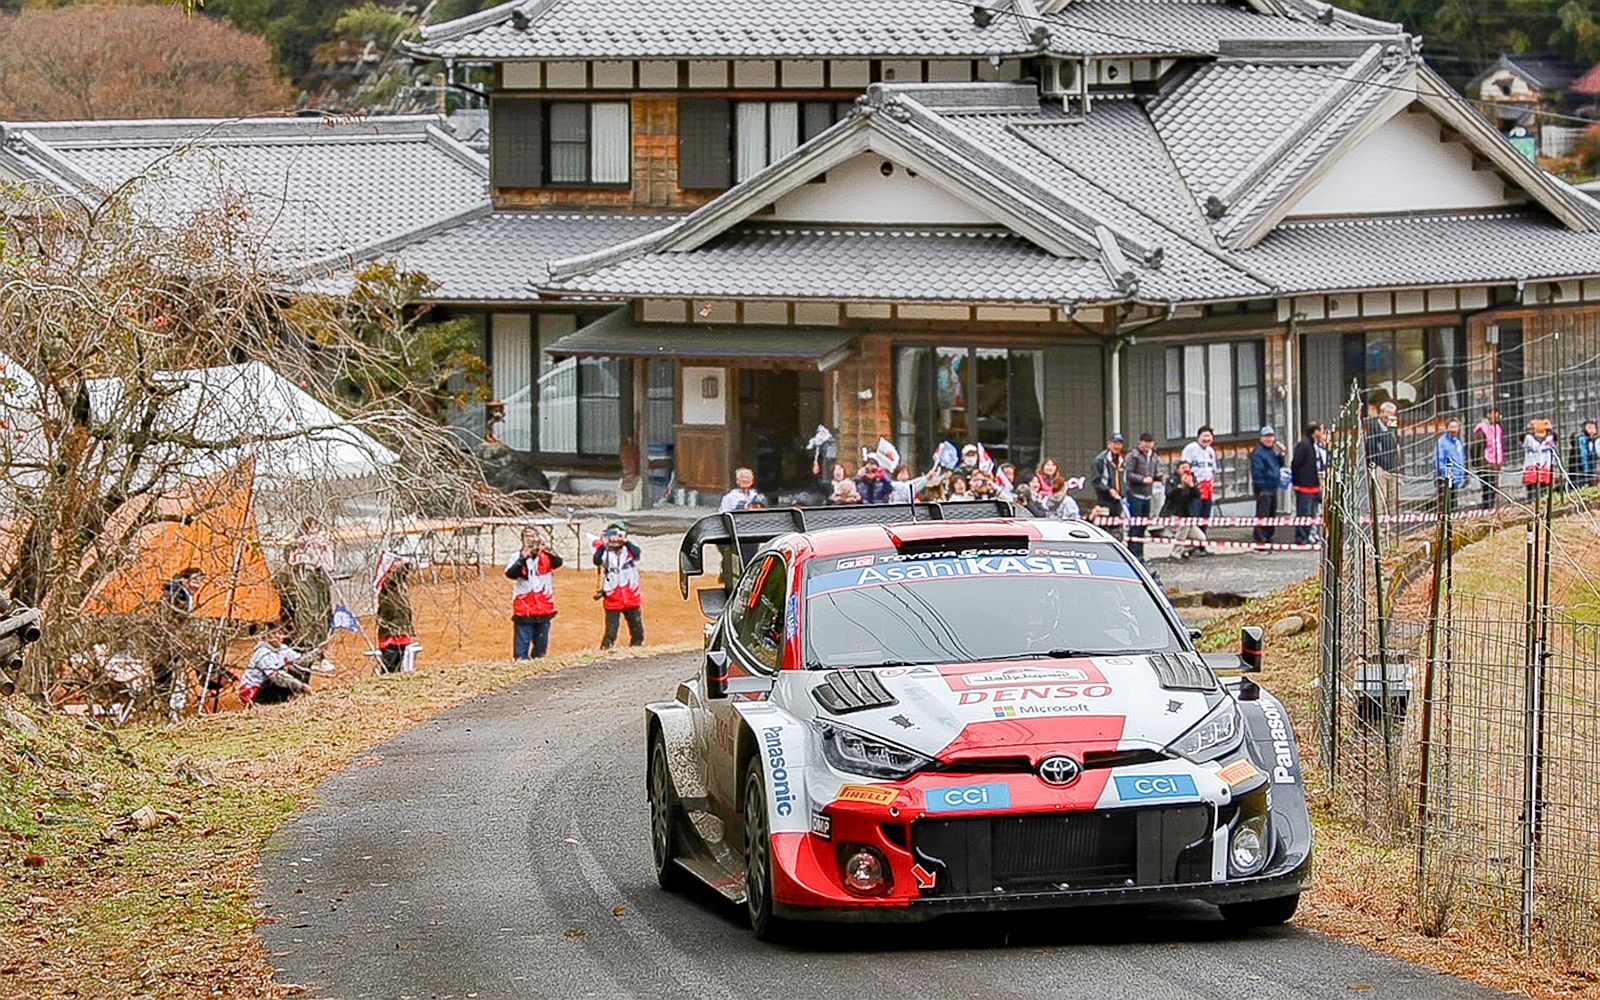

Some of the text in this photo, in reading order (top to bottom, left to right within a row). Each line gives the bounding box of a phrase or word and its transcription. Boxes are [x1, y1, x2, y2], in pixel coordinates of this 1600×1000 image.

[879, 551, 956, 563] TOYOTA
[959, 548, 1030, 558] GAZOO
[1034, 548, 1098, 560] Racing
[958, 686, 1113, 705] DENSO
[1019, 704, 1090, 714] Microsoft
[1260, 700, 1296, 784] Panason
[763, 726, 796, 817] Panasonic
[839, 785, 893, 802] PIRELLI
[813, 817, 830, 834] OMP
